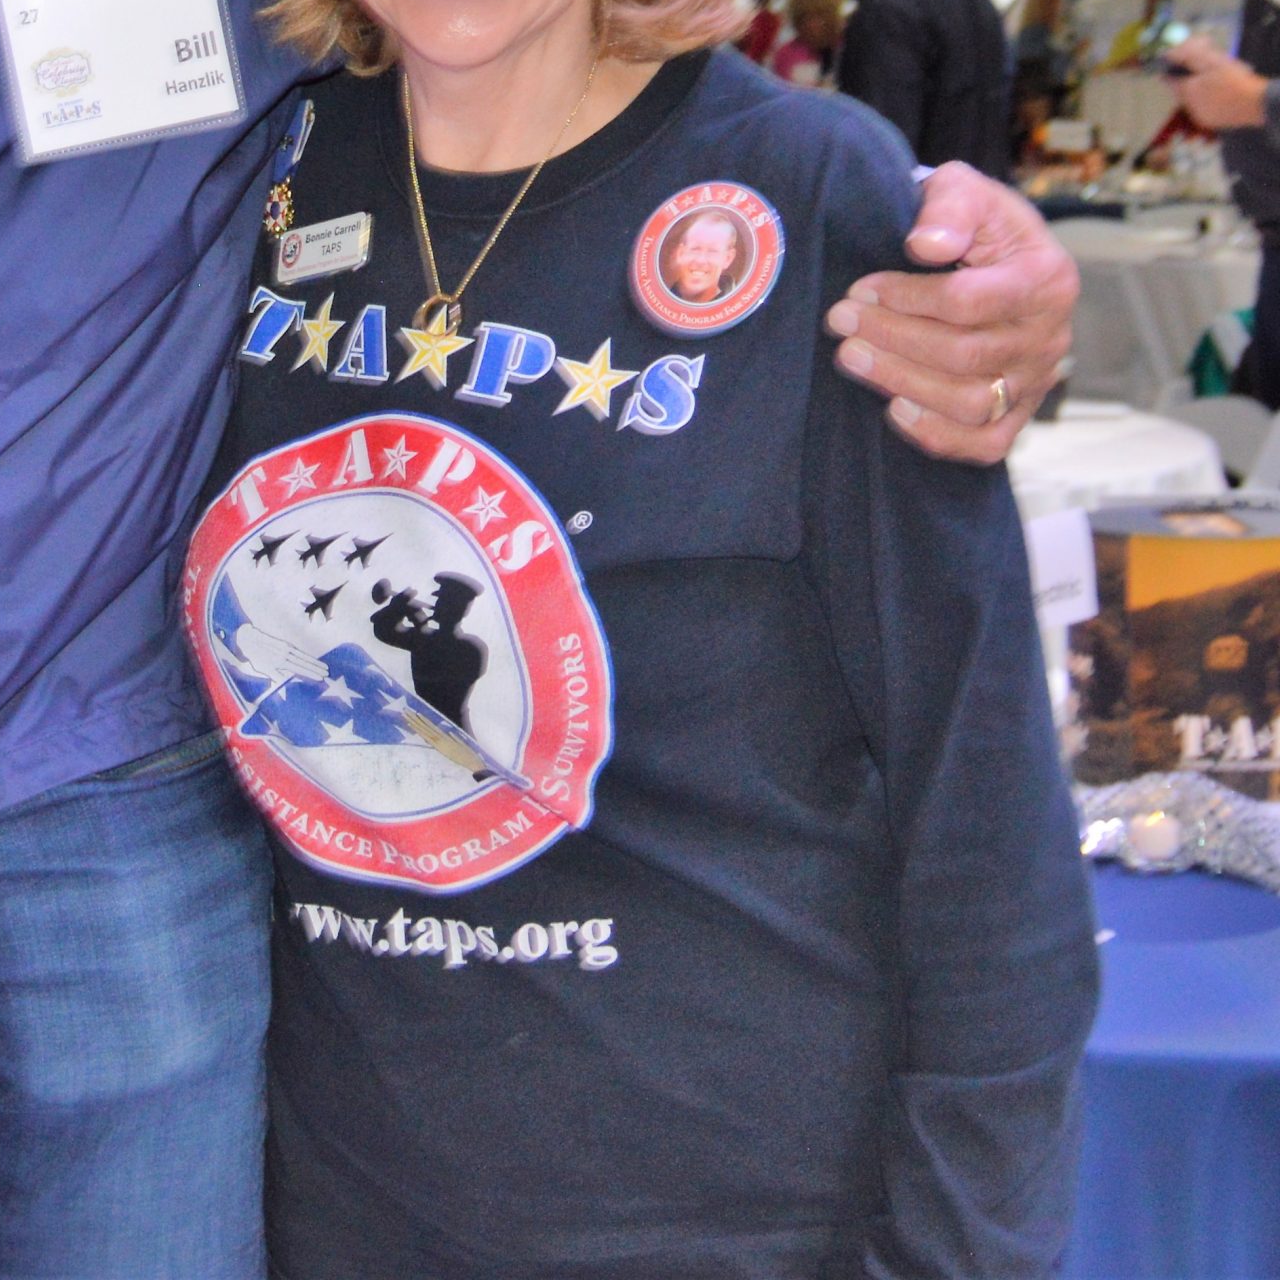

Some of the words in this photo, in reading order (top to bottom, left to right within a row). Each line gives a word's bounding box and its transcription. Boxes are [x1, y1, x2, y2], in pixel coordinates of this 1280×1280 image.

[19, 9, 39, 24] 27
[174, 30, 218, 63] Bill
[165, 69, 226, 95] Hanzlik
[305, 228, 333, 244] Bonnie
[334, 221, 361, 236] Carroll
[321, 241, 342, 256] TAPS
